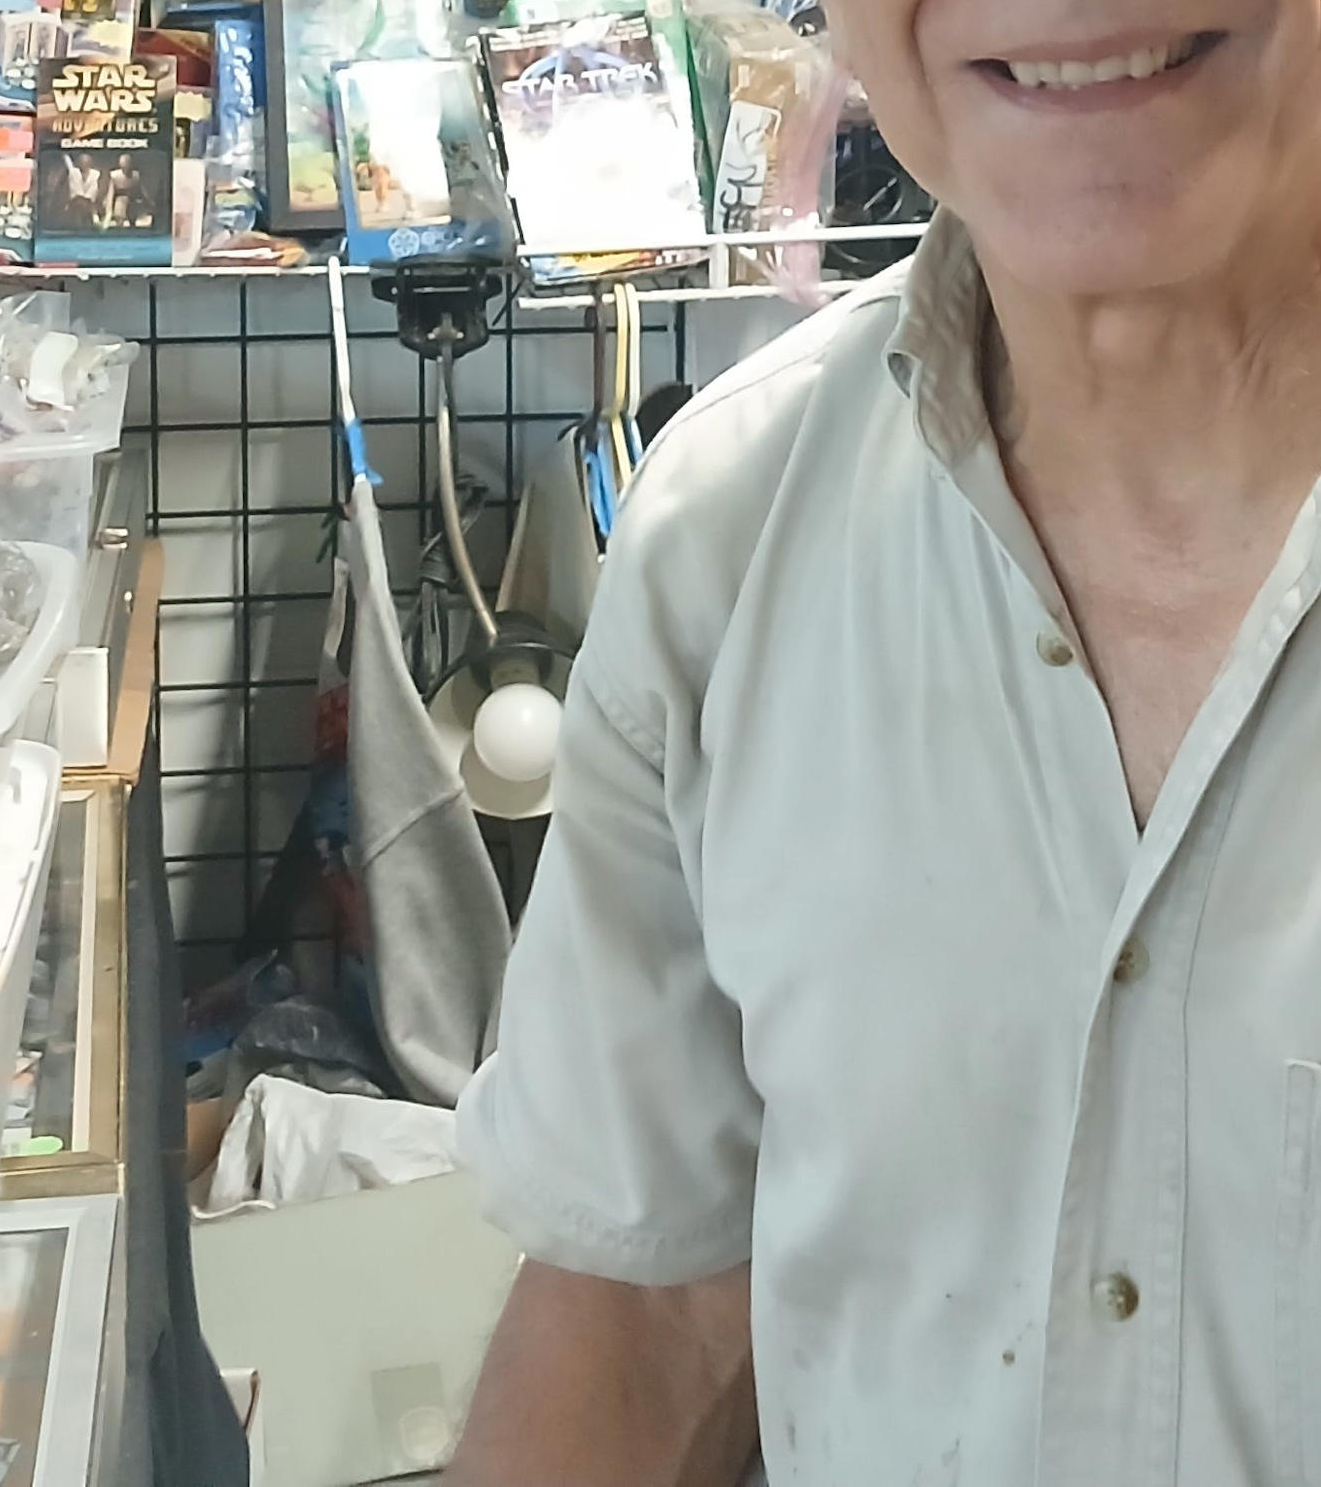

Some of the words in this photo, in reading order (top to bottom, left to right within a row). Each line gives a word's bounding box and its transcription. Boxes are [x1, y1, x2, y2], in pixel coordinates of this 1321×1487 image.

[52, 64, 156, 90] STAR
[501, 73, 579, 99] STAR
[581, 62, 659, 95] TREK
[52, 87, 156, 113] WARS
[61, 138, 102, 150] GAME
[107, 138, 149, 150] BOOK
